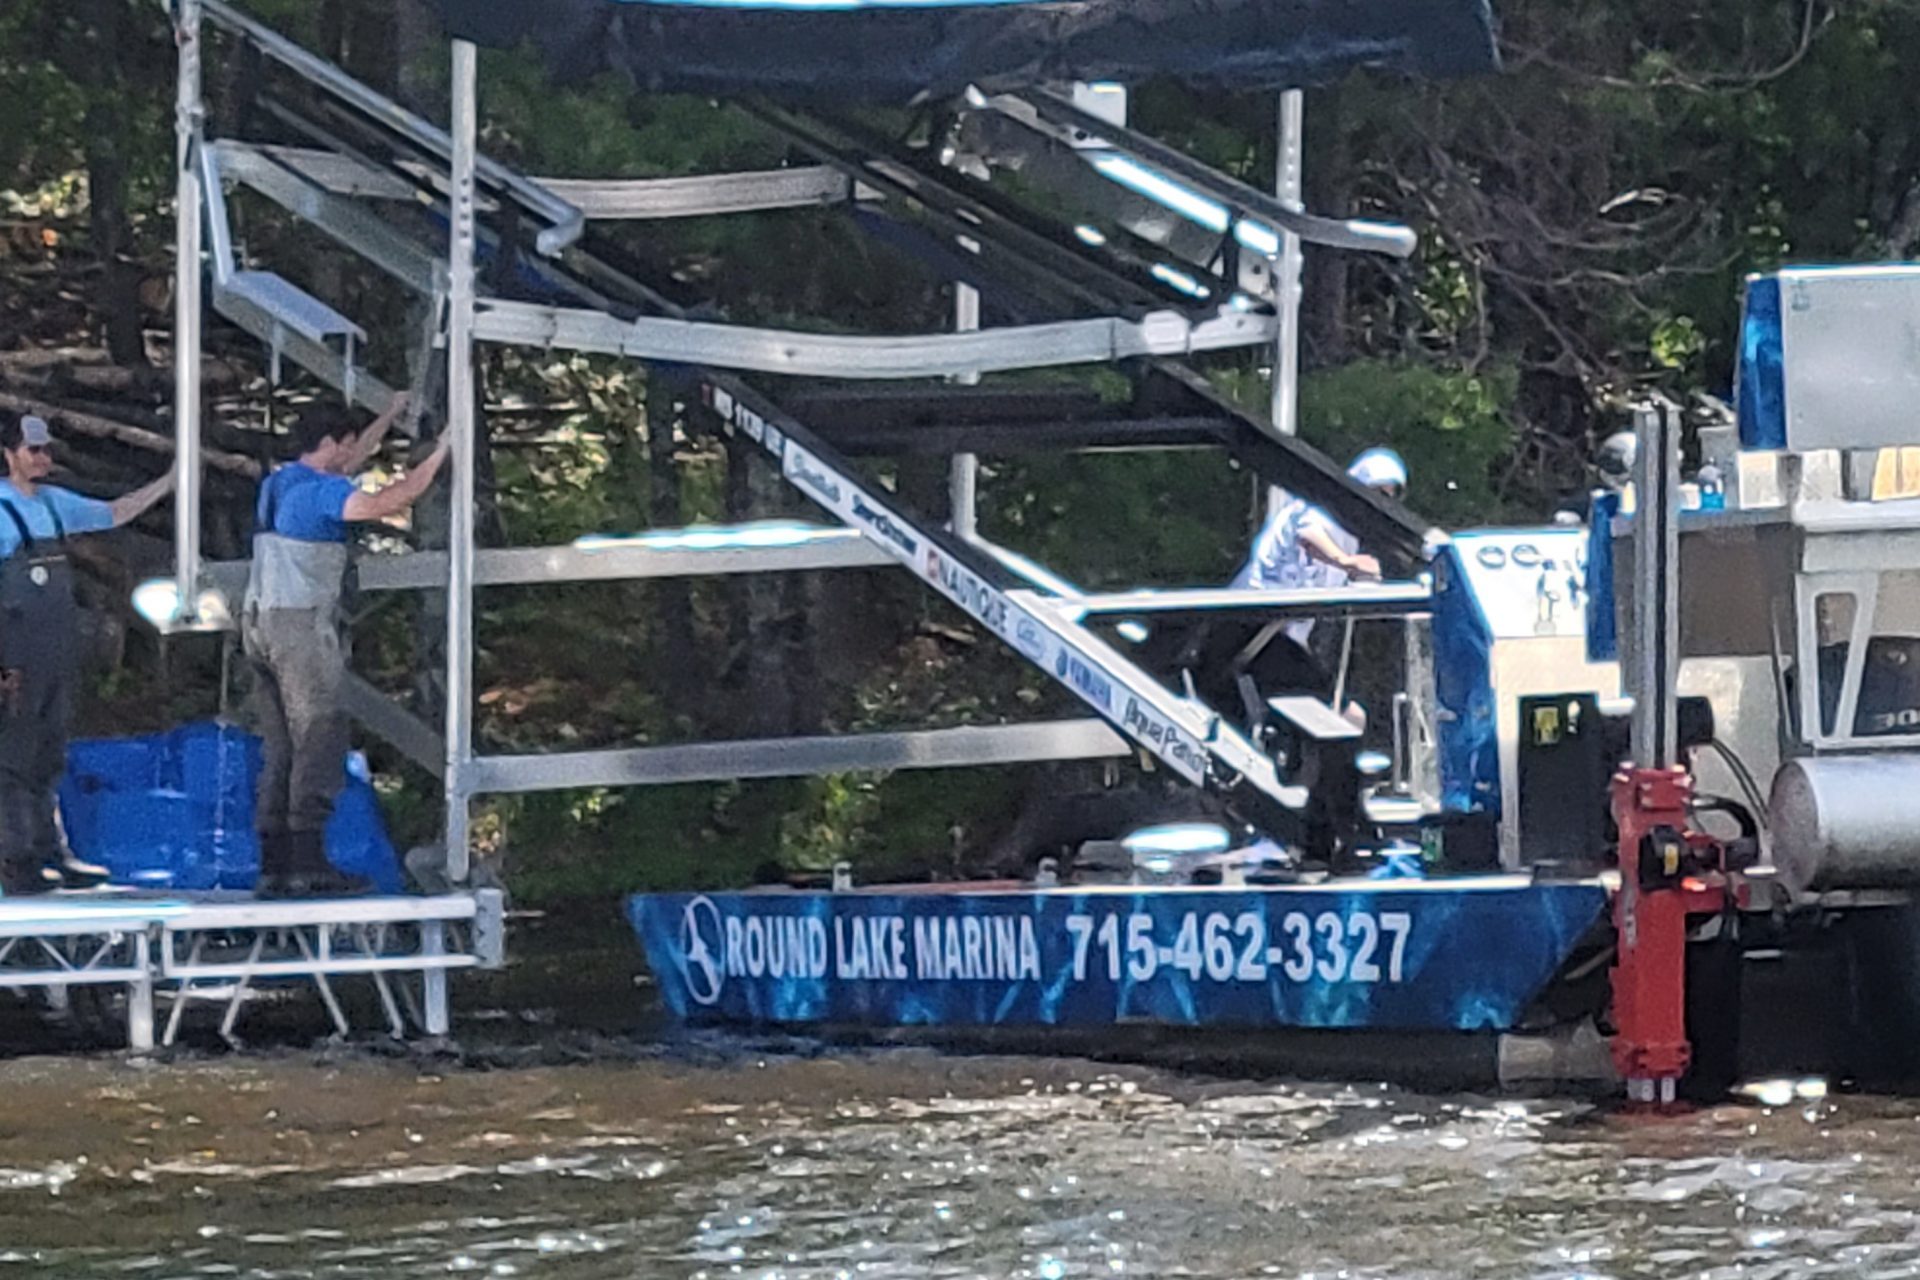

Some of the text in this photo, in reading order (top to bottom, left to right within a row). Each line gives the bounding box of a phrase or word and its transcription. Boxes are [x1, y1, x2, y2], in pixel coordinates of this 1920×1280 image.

[726, 912, 1411, 982] ROUND LAKE MARINA 715-462-3327
